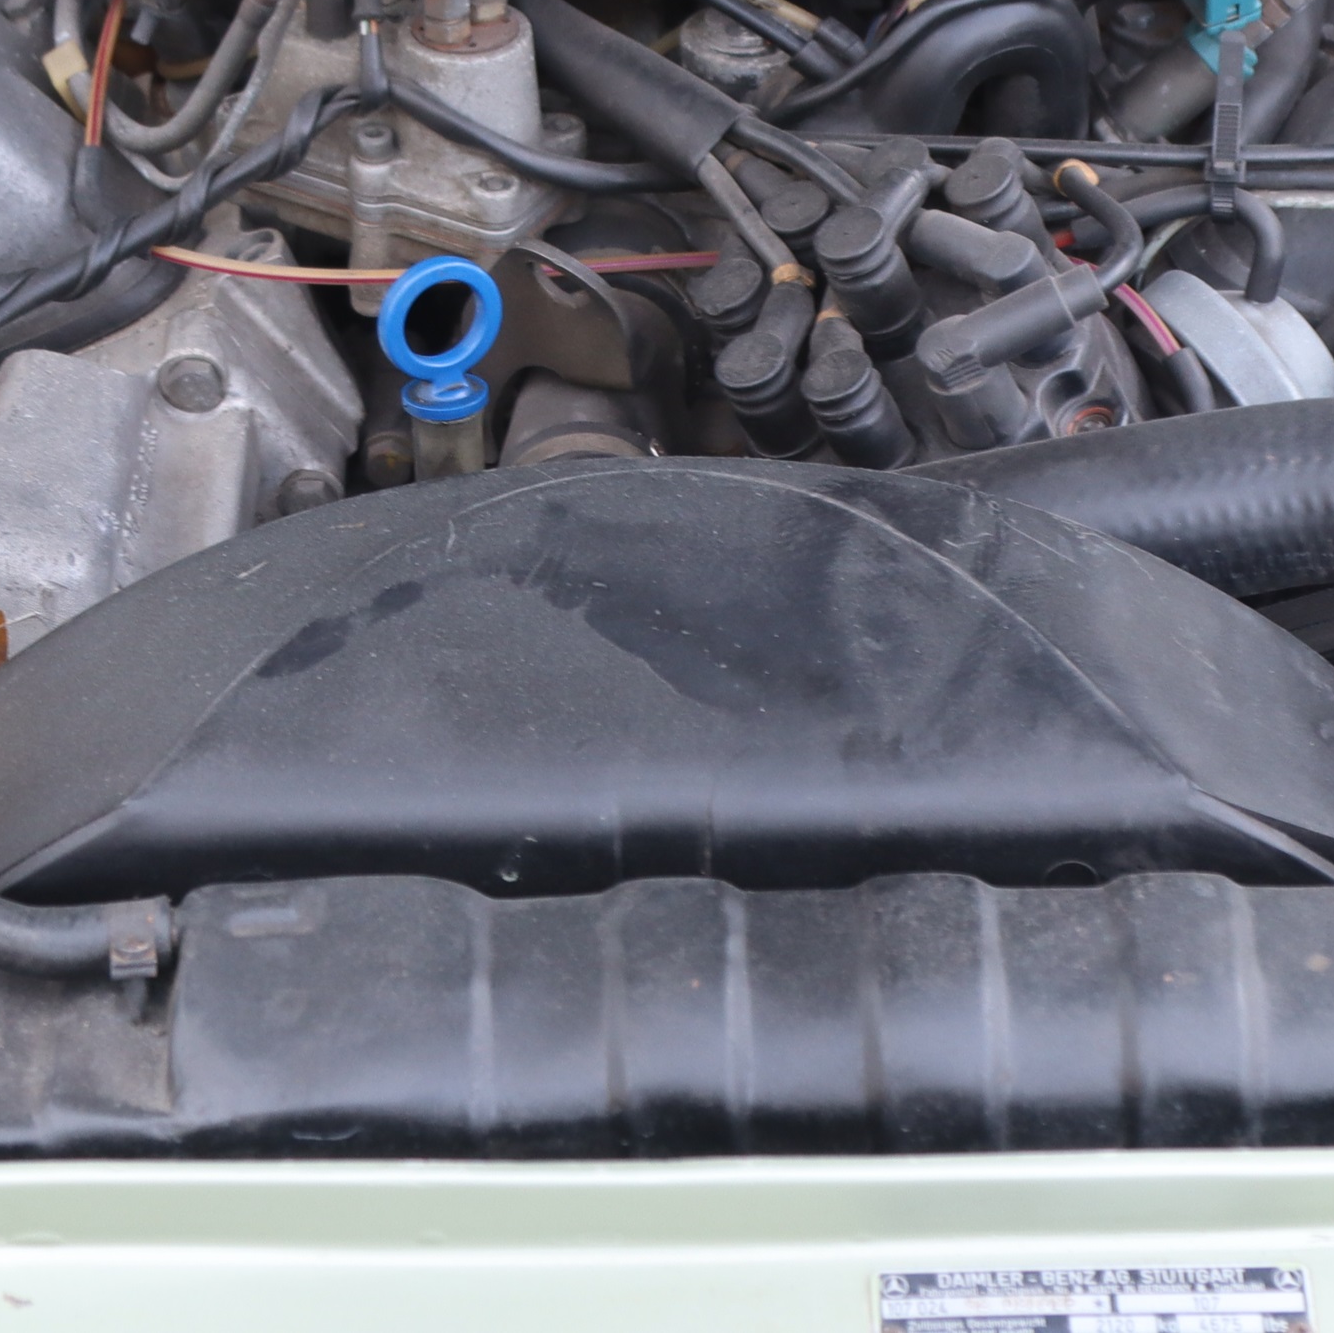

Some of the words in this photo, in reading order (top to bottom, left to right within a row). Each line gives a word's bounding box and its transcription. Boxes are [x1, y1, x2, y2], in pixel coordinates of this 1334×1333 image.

[937, 1272, 1024, 1289] DAIMLER
[1041, 1271, 1098, 1286] BENZ
[1139, 1268, 1246, 1285] STUTTGART
